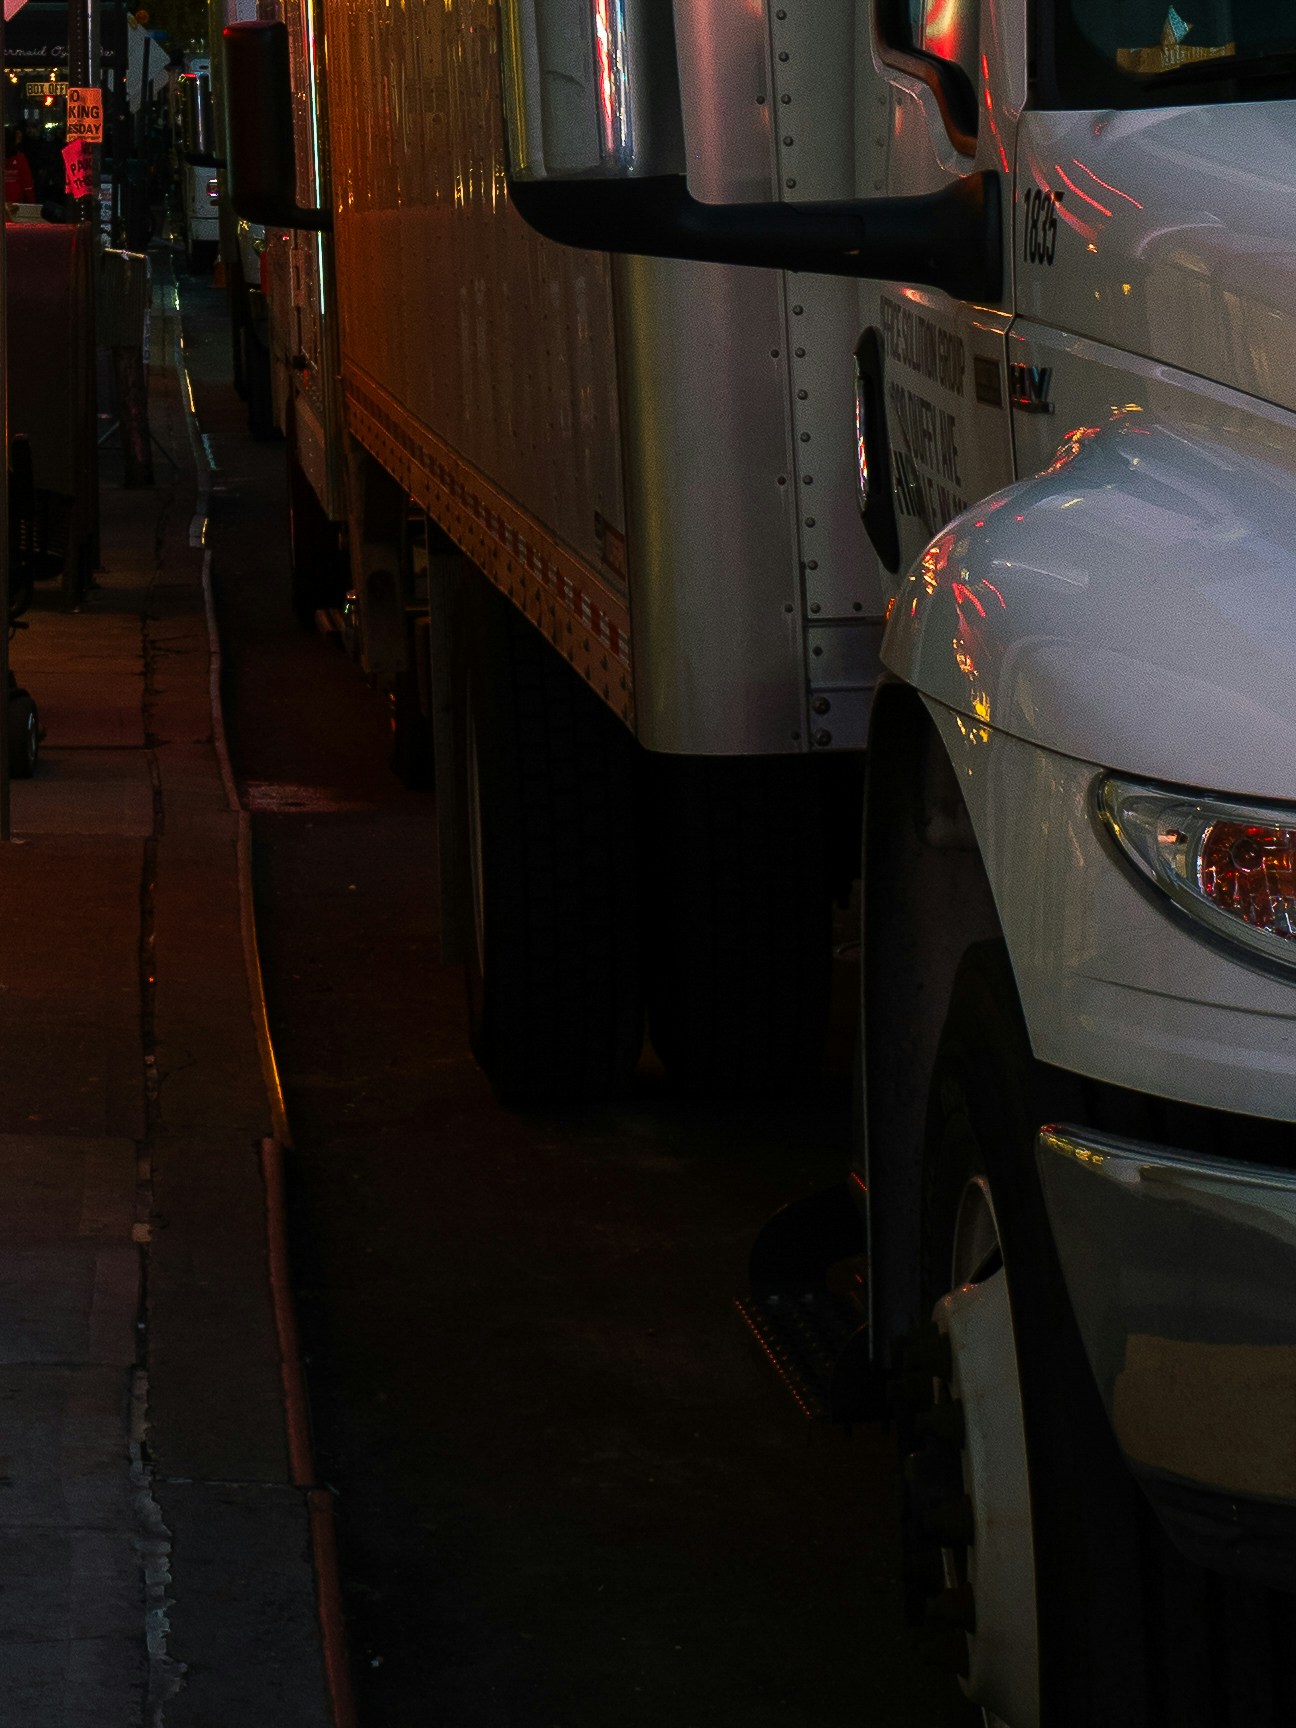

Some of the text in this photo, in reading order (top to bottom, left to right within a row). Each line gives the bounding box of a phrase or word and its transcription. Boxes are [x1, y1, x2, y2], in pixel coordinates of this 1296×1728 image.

[4, 44, 47, 57] ermaid
[26, 83, 44, 95] BOX
[68, 105, 101, 120] KING
[68, 123, 102, 136] ESDAY
[1023, 186, 1064, 266] 1835
